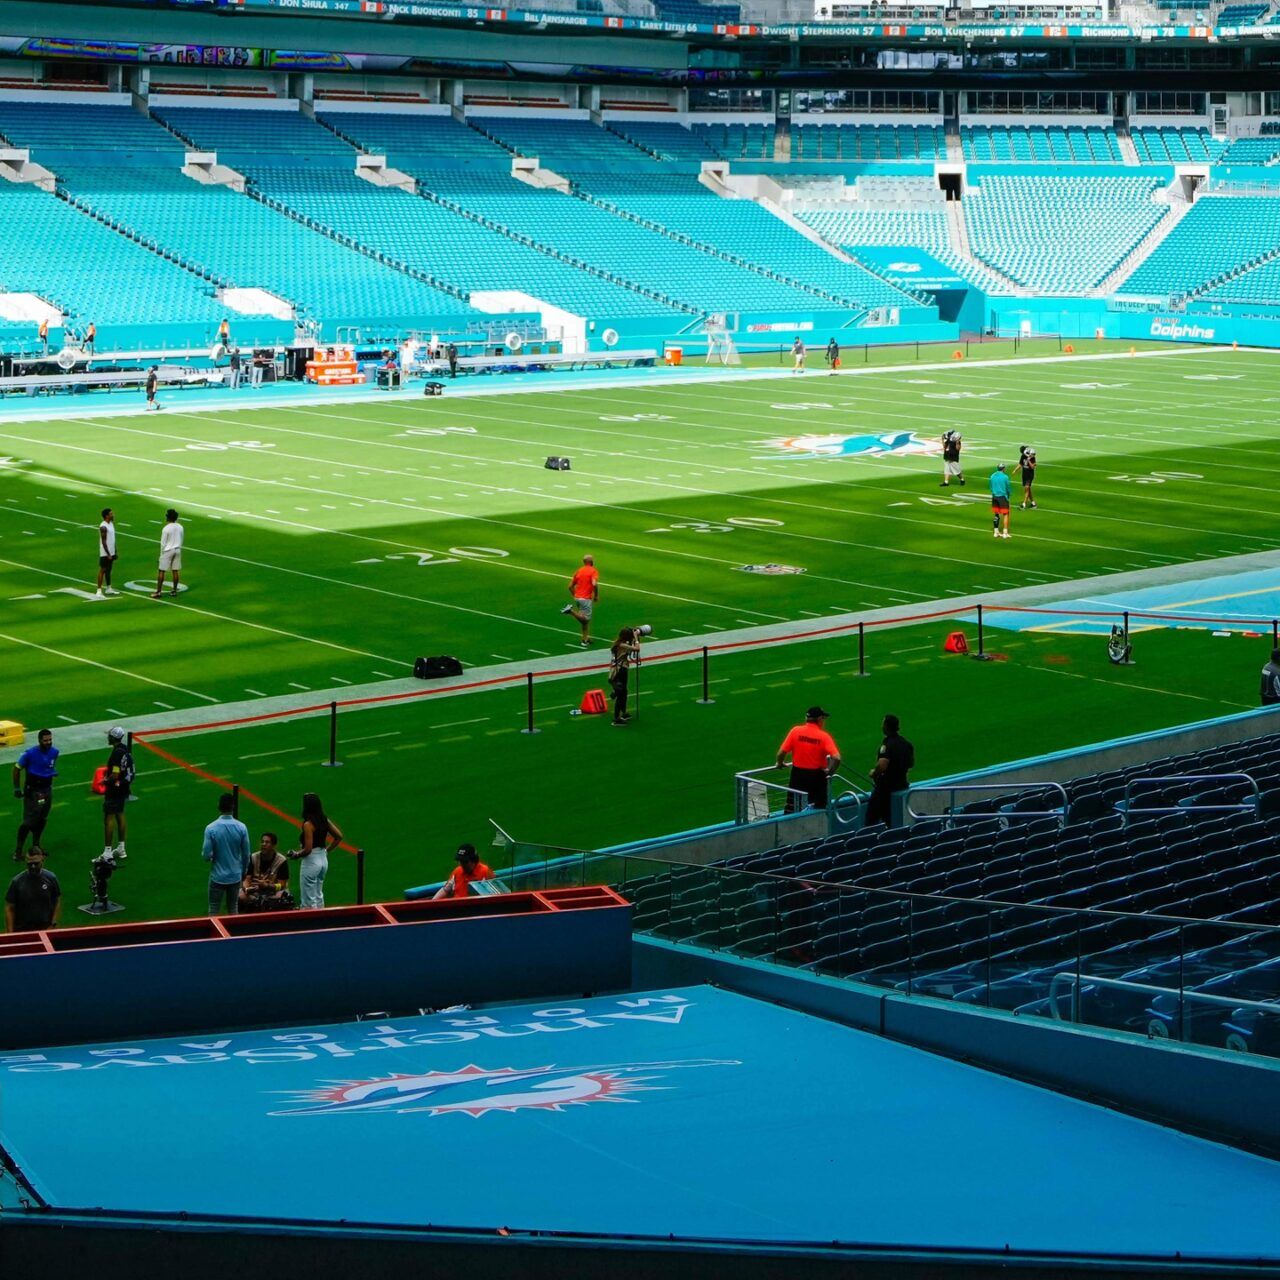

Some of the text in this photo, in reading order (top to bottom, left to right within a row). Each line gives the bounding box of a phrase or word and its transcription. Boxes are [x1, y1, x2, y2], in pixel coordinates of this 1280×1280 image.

[389, 3, 478, 18] NICK BUONICONTI 85
[524, 13, 539, 21] BILL
[640, 20, 663, 30] LARRY
[687, 24, 697, 32] 66
[762, 26, 875, 35] DWIGHT STEPHENSON 57
[925, 27, 1025, 36] BOB KUECHENBERG 67
[1082, 27, 1130, 37] RICHMOND
[1163, 27, 1175, 36] 78
[1150, 323, 1214, 340] Dolphins
[953, 634, 968, 651] 20
[591, 692, 606, 712] 10
[7, 1002, 697, 1072] AmeriSave
